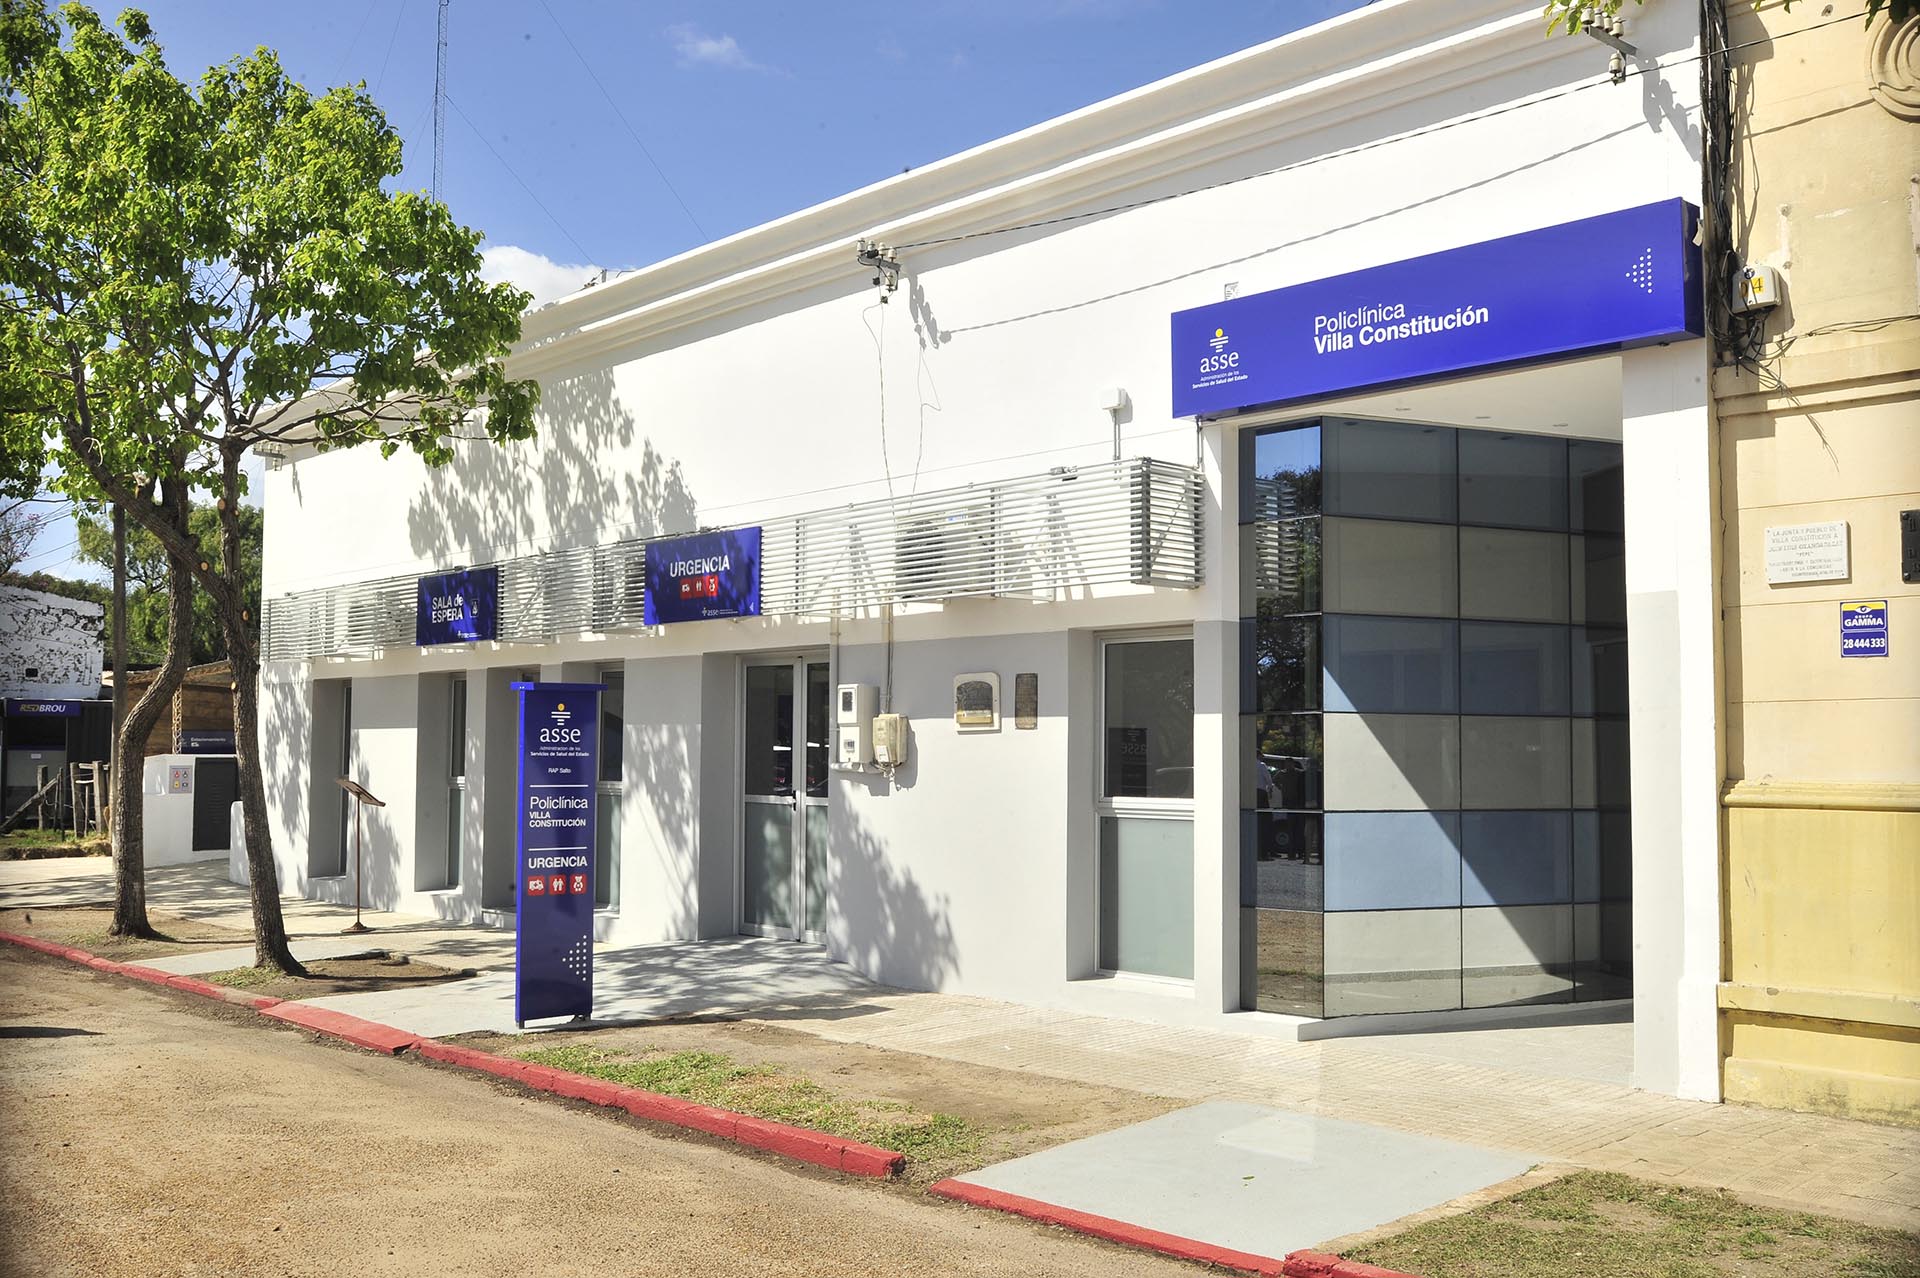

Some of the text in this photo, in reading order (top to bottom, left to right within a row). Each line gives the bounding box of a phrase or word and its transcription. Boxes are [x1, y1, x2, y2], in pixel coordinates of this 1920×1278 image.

[1314, 303, 1406, 335] Policlínica
[1313, 305, 1489, 355] Villa Constitución
[1200, 351, 1239, 373] asse
[1192, 381, 1210, 389] Servicios
[670, 554, 730, 578] URGENCIA
[432, 593, 464, 610] SALA de
[432, 607, 463, 623] ESPERA
[1844, 618, 1884, 627] GAMMA
[539, 728, 581, 743] asse
[530, 795, 588, 809] Policlínica
[529, 811, 551, 819] VILLA
[529, 817, 586, 828] CONSTITUCIÓN
[528, 856, 588, 869] URGENCIA
